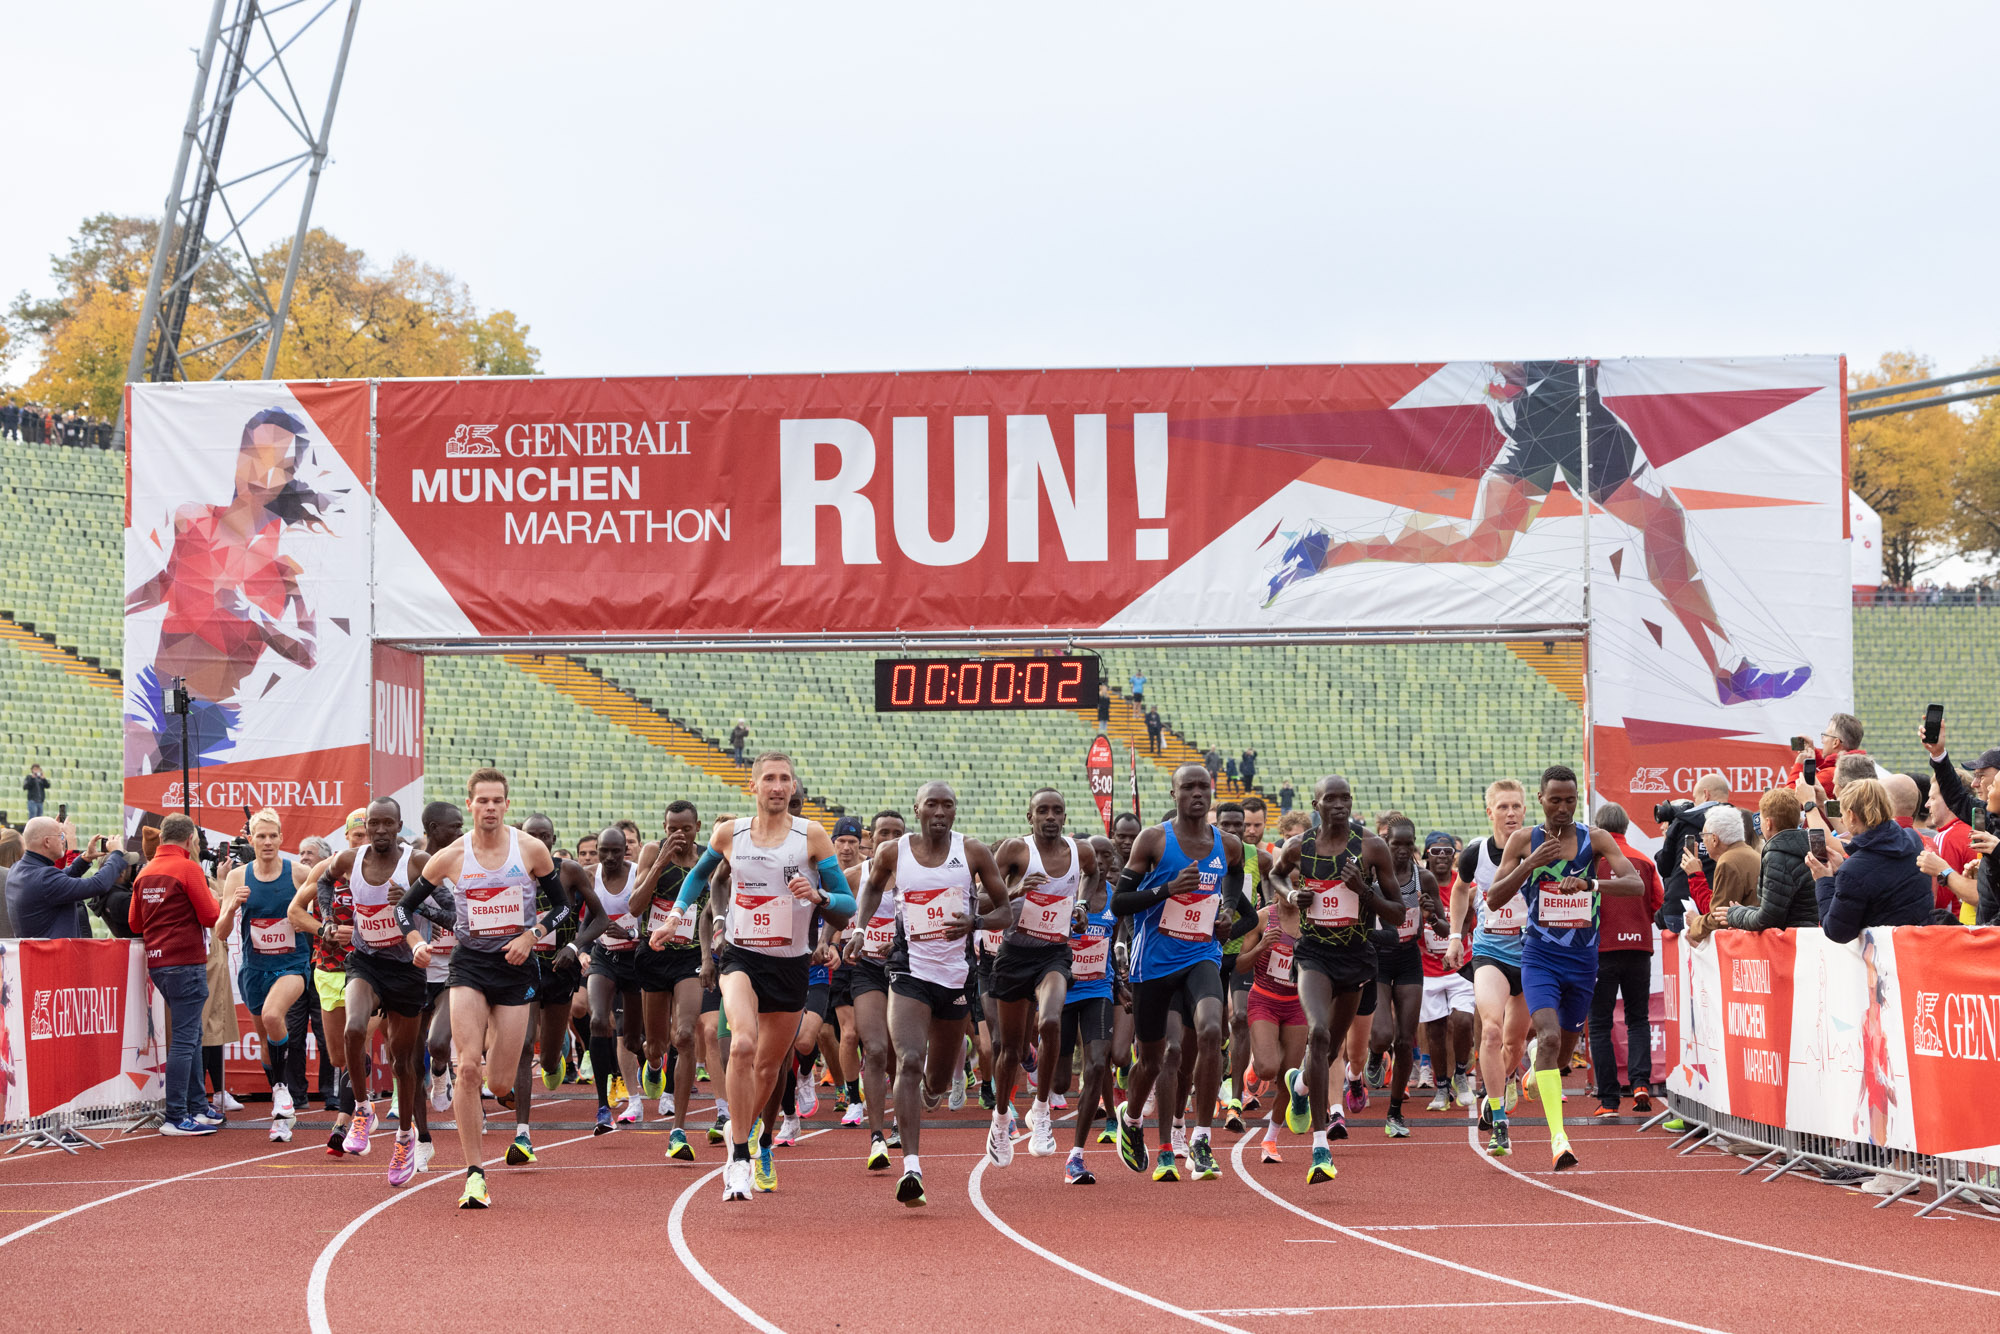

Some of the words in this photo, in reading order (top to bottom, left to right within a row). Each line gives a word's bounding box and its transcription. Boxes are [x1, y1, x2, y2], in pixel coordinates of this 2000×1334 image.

[504, 420, 692, 457] GENERALI
[411, 465, 640, 503] MÜNCHEN
[779, 412, 1170, 567] RUN!
[504, 508, 731, 545] MARATHON
[890, 662, 1083, 706] 00:00:02
[375, 679, 420, 758] RUN!
[1091, 775, 1112, 794] 3:00
[206, 780, 344, 807] GENERALI
[1322, 896, 1339, 908] 99
[1543, 897, 1589, 908] BERHANE
[472, 903, 520, 915] SEBASTIAN
[927, 906, 944, 920] 94
[1322, 908, 1340, 916] PACE
[1499, 908, 1513, 919] 70
[753, 913, 770, 926] 95
[1041, 910, 1058, 923] 97
[1184, 910, 1201, 923] 98
[360, 918, 399, 931] JUSTU
[752, 927, 771, 935] PACE
[1038, 922, 1055, 931] PACE
[1180, 922, 1199, 931] PACE
[260, 933, 286, 943] 4670
[1740, 959, 1772, 994] GENERALI
[53, 986, 118, 1038] GENERALI
[1728, 1001, 1766, 1040] MÜNCHEN
[1743, 1047, 1783, 1087] MARATHON
